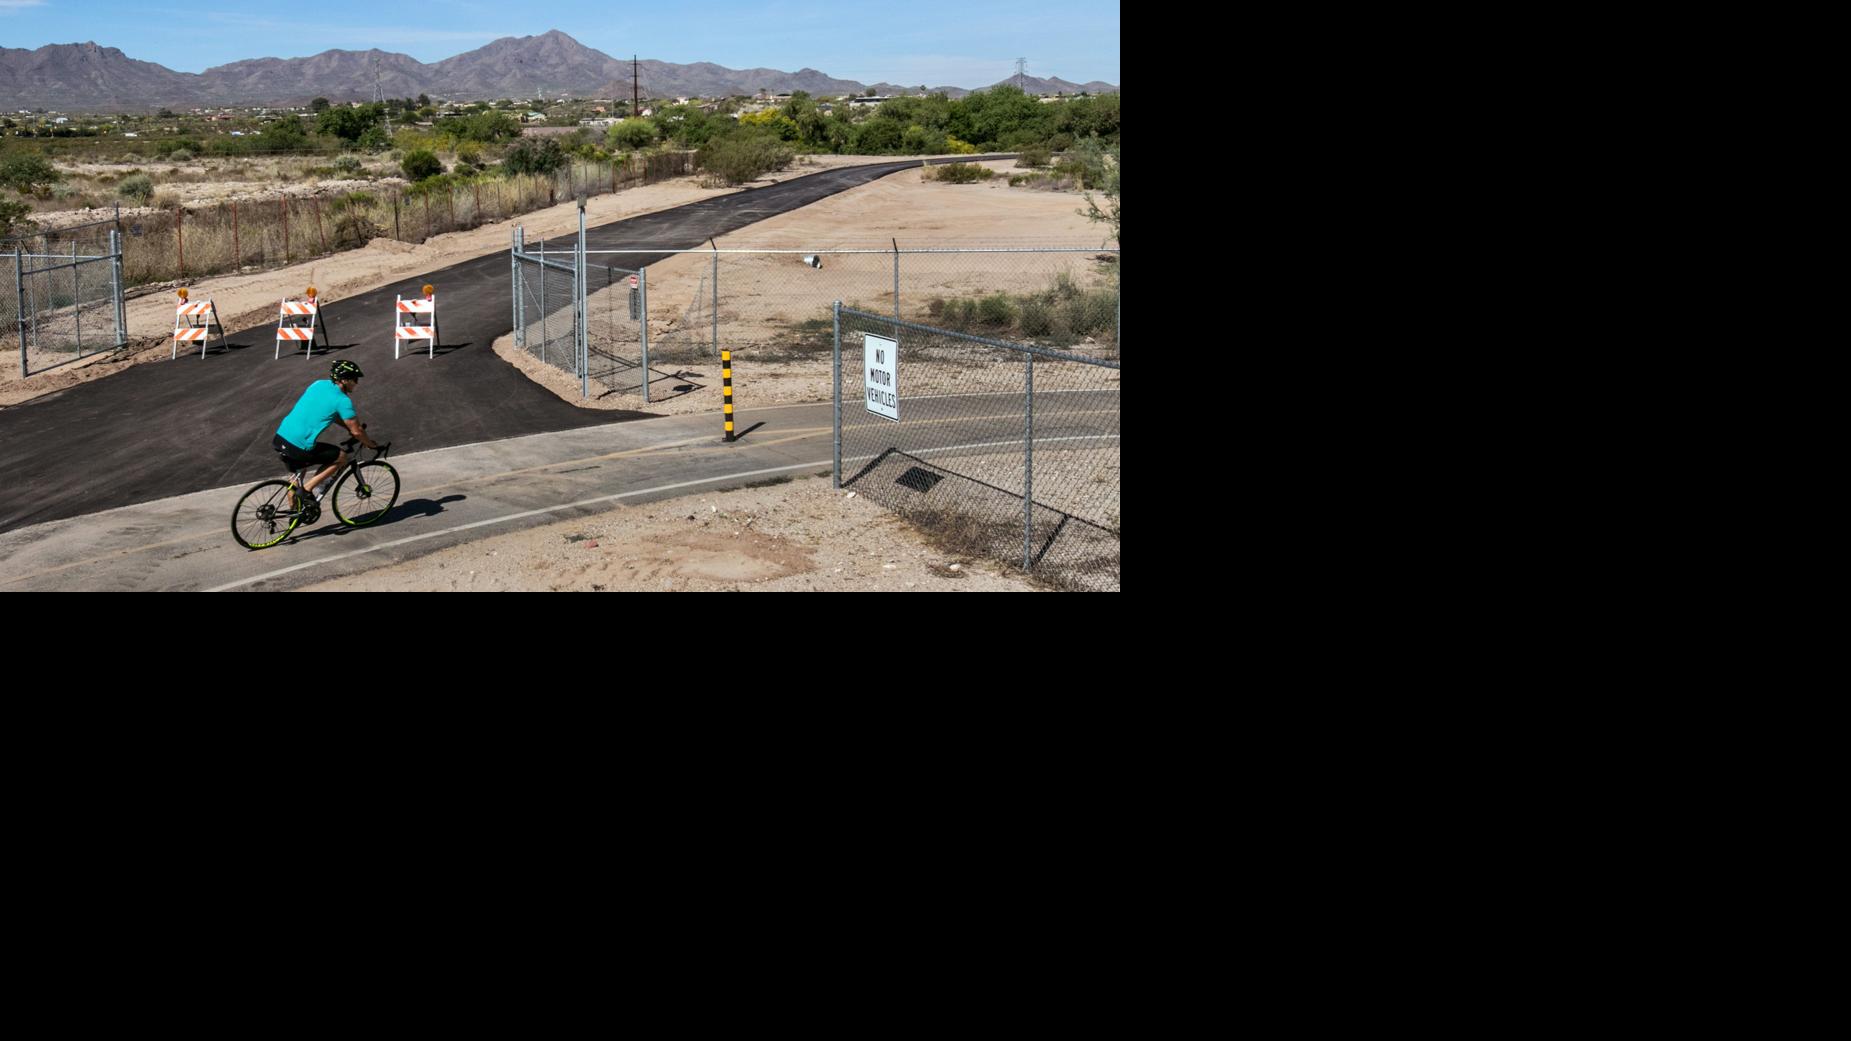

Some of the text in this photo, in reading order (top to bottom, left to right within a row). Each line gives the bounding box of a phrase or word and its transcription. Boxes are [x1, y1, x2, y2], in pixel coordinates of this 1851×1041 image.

[876, 349, 885, 364] NO
[870, 368, 890, 387] MOTOR
[867, 386, 895, 408] VEHICLES
